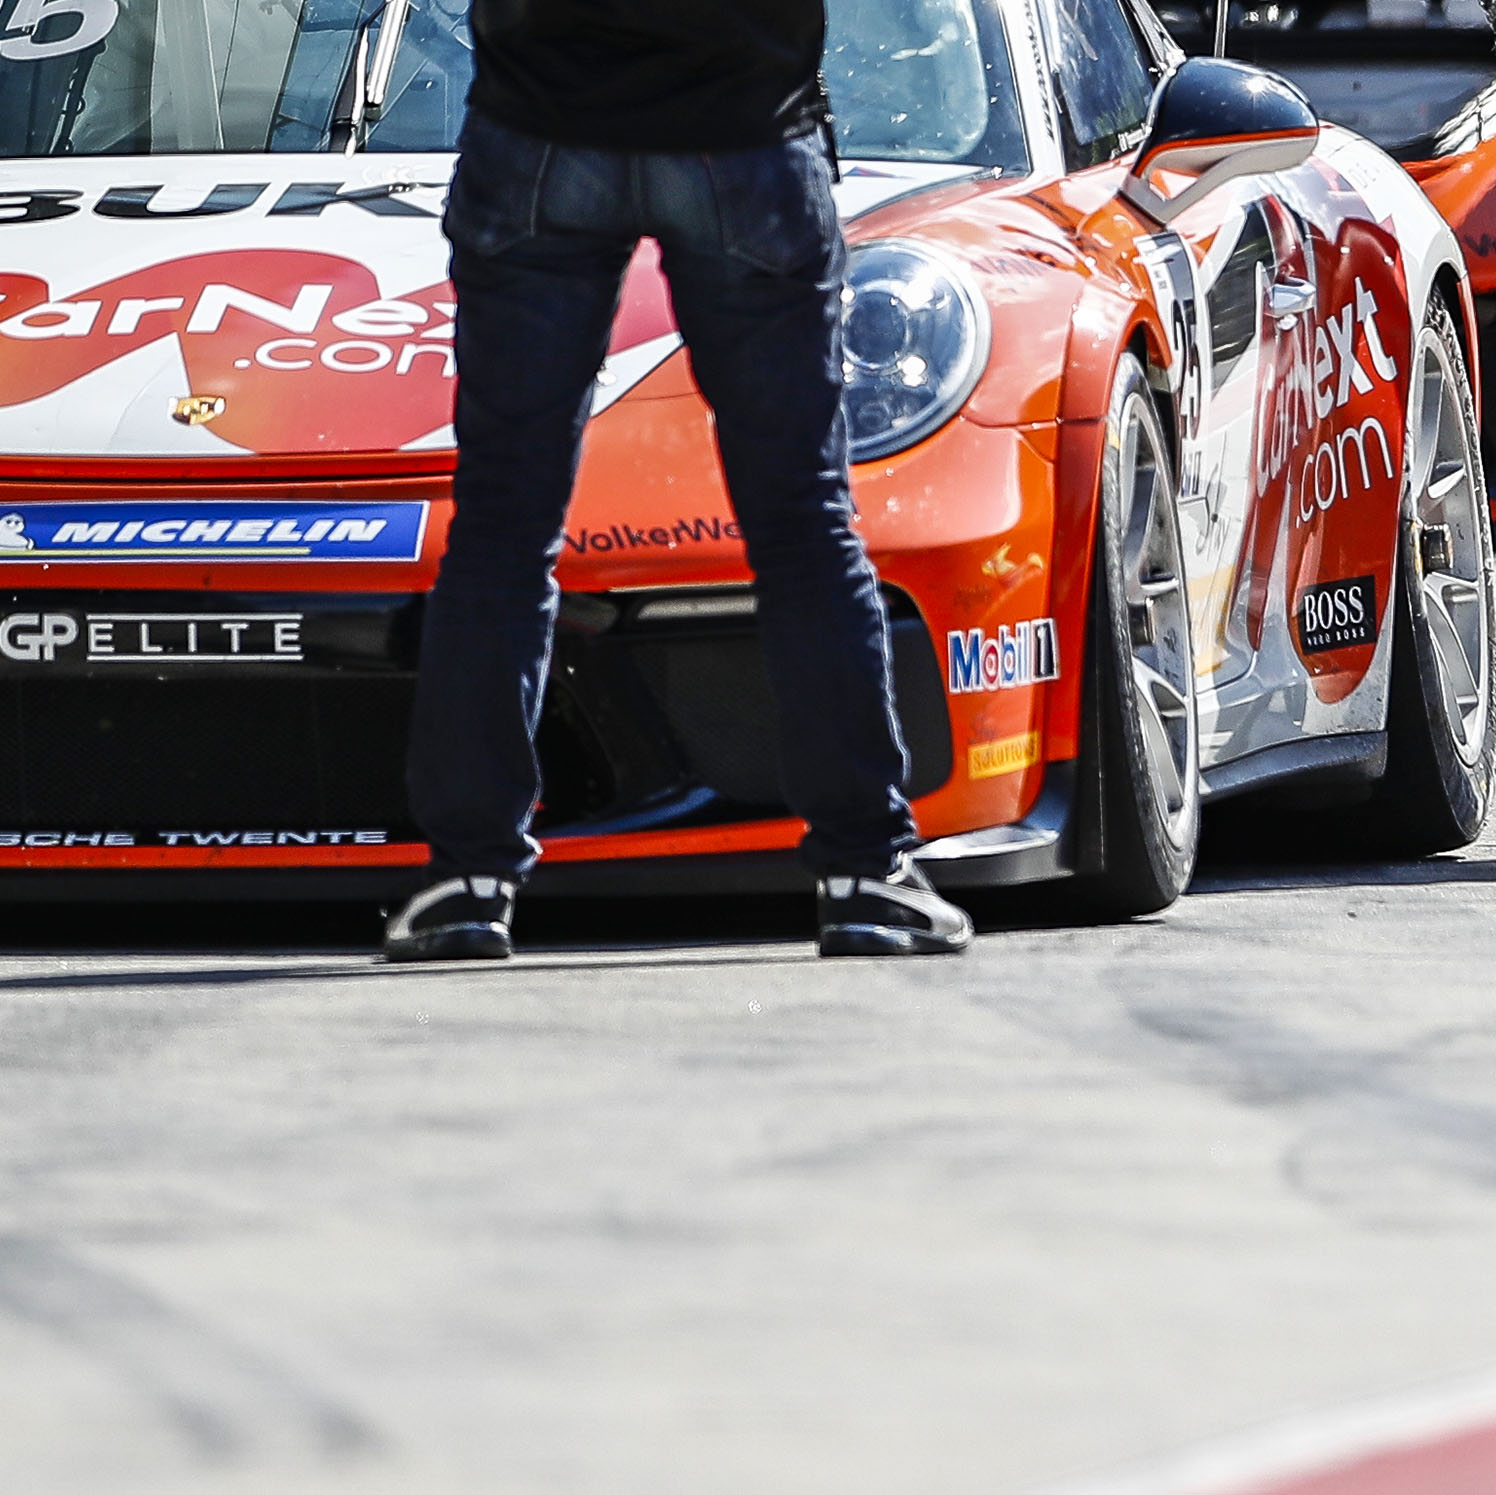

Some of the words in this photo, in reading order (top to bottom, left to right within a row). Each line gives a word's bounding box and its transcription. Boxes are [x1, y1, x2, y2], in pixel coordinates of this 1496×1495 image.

[1295, 416, 1394, 529] .com
[51, 517, 387, 544] MICHELIN
[564, 517, 745, 554] VolkerWe
[1304, 585, 1364, 633] BOSS
[948, 623, 1030, 693] Mobil
[158, 829, 389, 845] TWENTE
